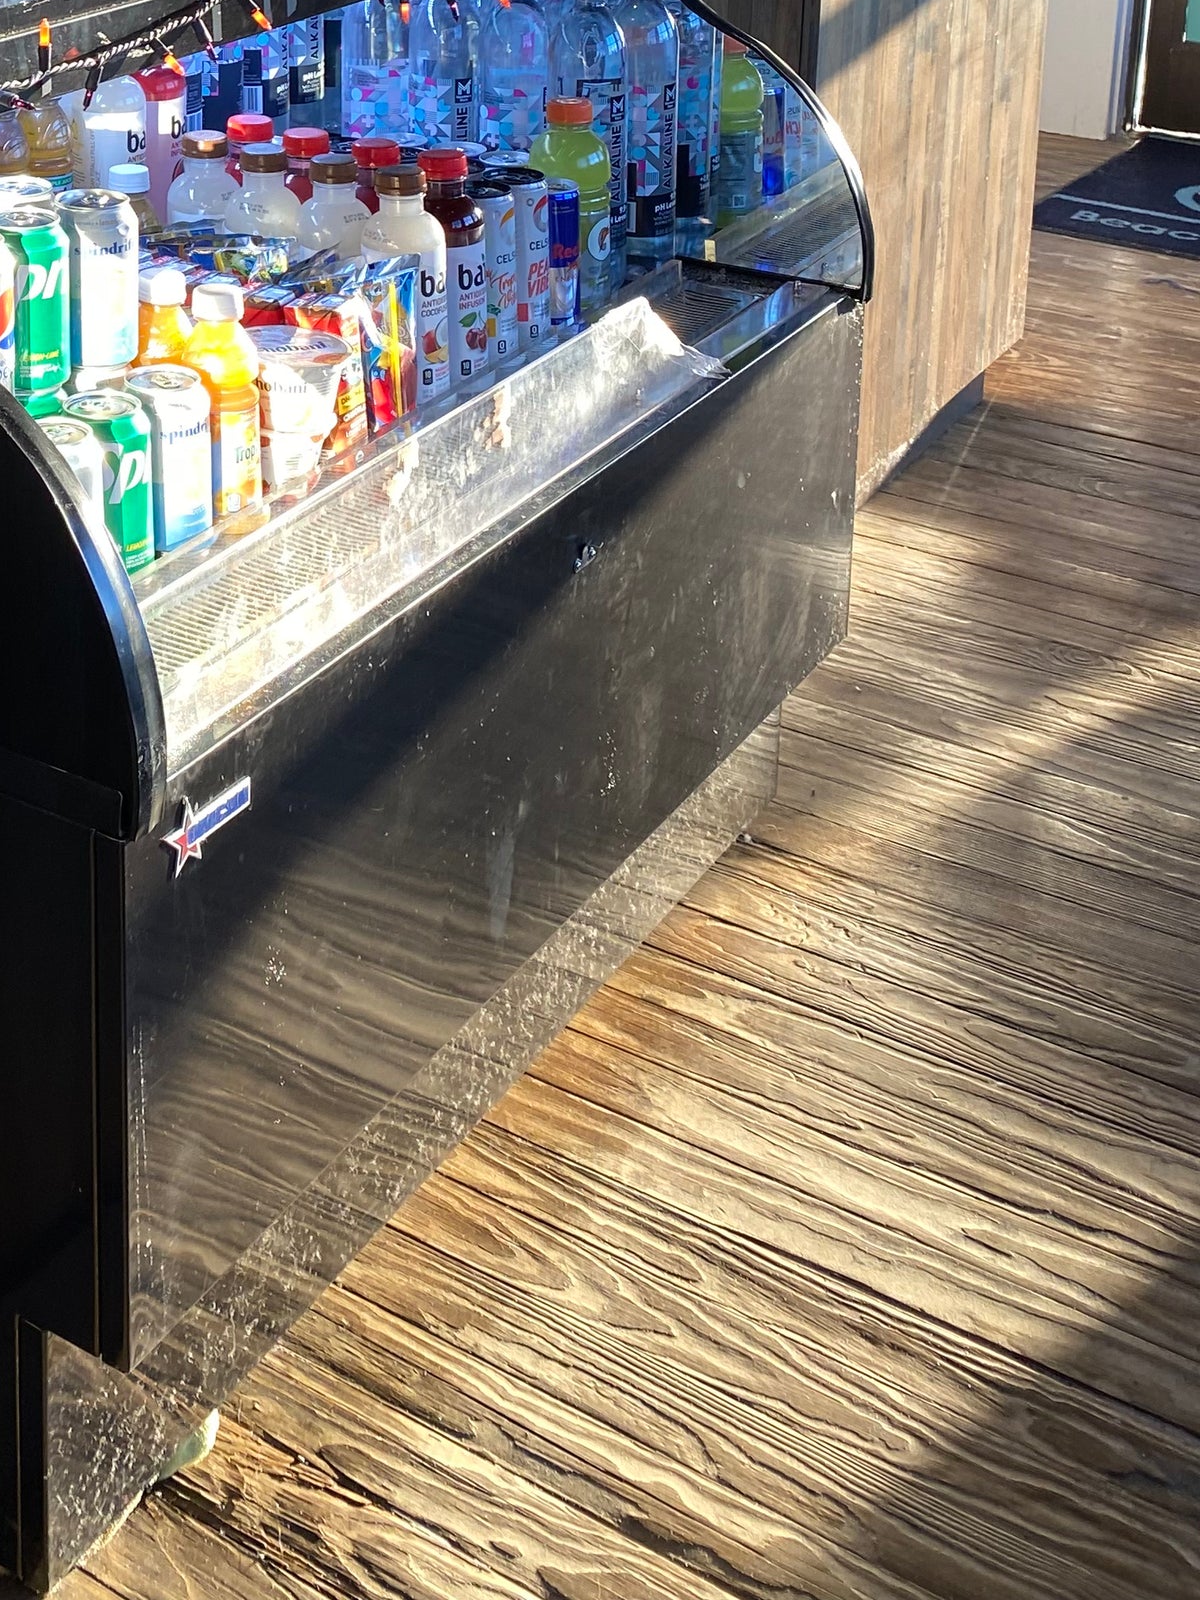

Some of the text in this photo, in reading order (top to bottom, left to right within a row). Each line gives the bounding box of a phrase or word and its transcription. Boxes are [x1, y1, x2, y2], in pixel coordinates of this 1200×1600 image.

[127, 129, 146, 153] ba
[663, 113, 674, 189] ALKALINE
[610, 125, 621, 202] ALKALINE
[1069, 210, 1200, 241] Beac
[420, 270, 446, 297] ba
